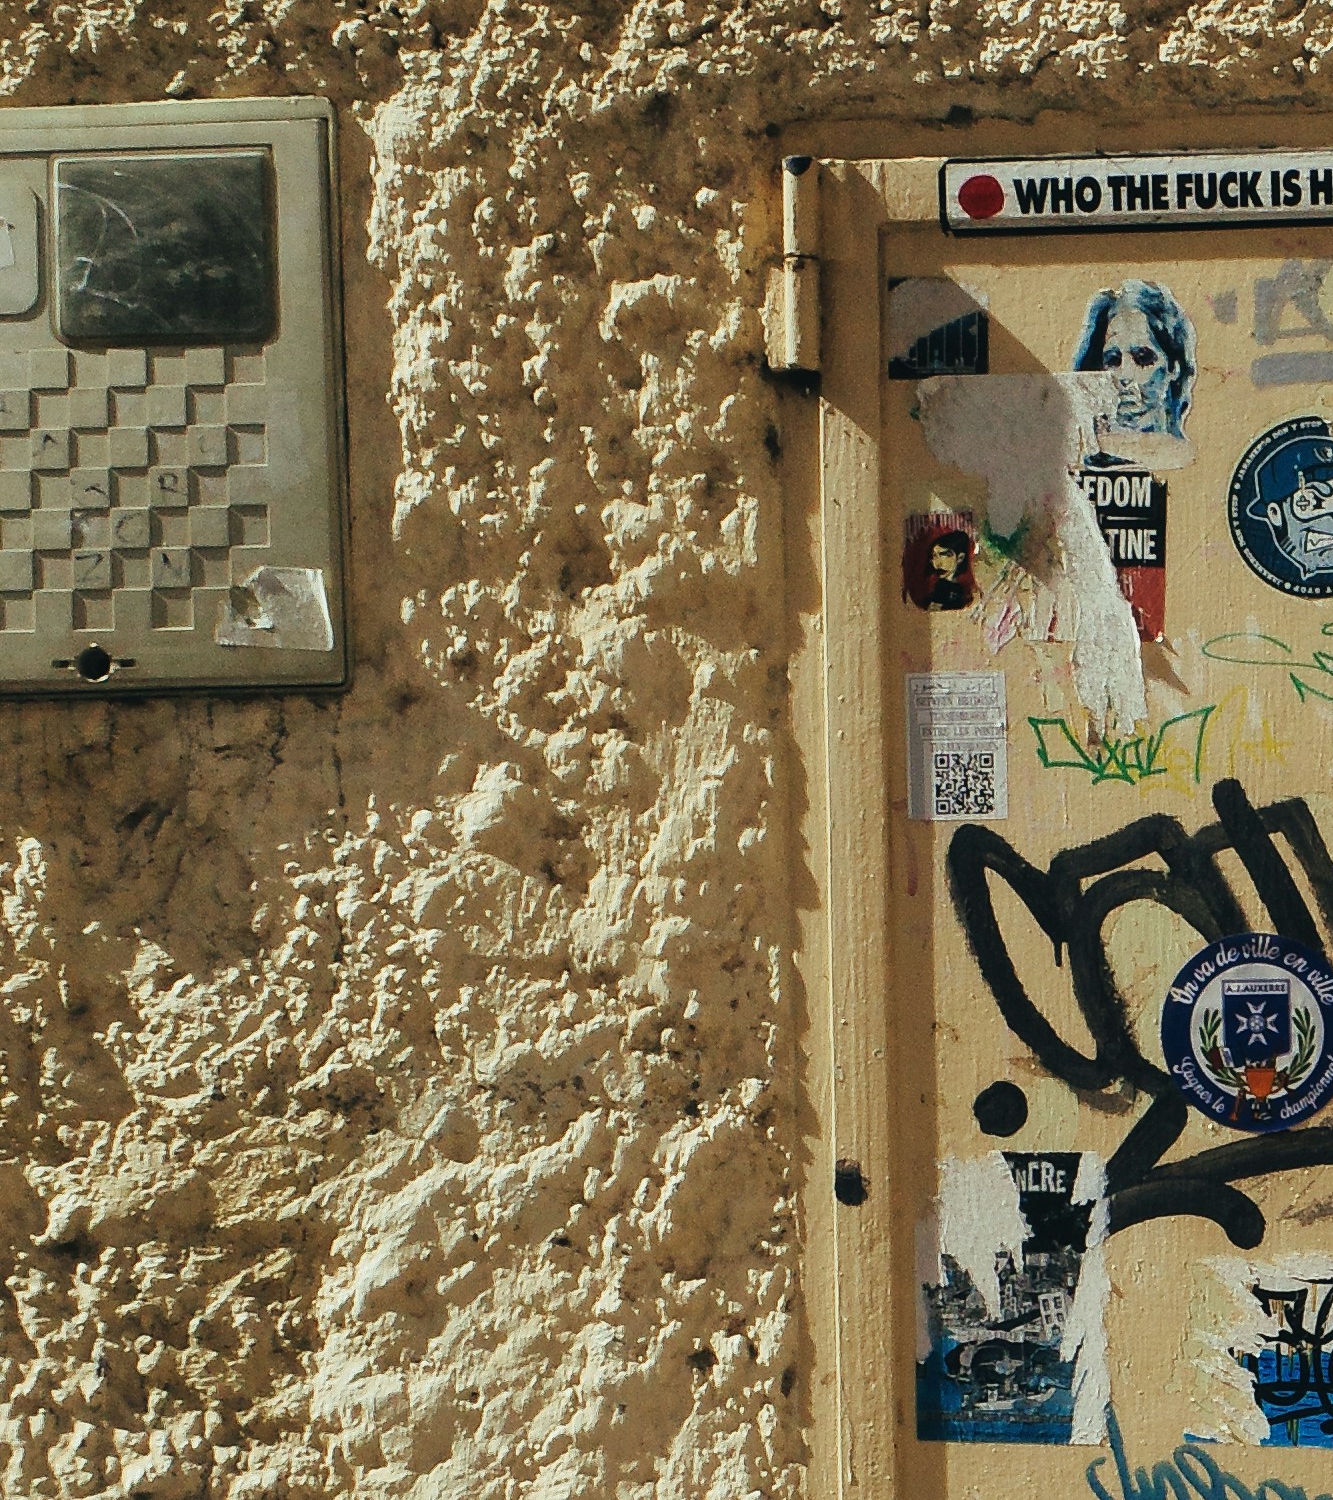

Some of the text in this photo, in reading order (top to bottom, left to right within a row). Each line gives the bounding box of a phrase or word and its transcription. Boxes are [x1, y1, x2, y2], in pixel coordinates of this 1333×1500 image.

[1013, 176, 1101, 213] WHO
[1107, 174, 1169, 211] THE
[1176, 171, 1264, 209] FUCK
[1271, 169, 1301, 207] IS
[1076, 475, 1151, 508] EDOM
[1194, 960, 1216, 982] va
[1215, 943, 1240, 967] de
[1241, 936, 1280, 960] ville
[1283, 952, 1309, 973] en
[1211, 1095, 1225, 1113] le
